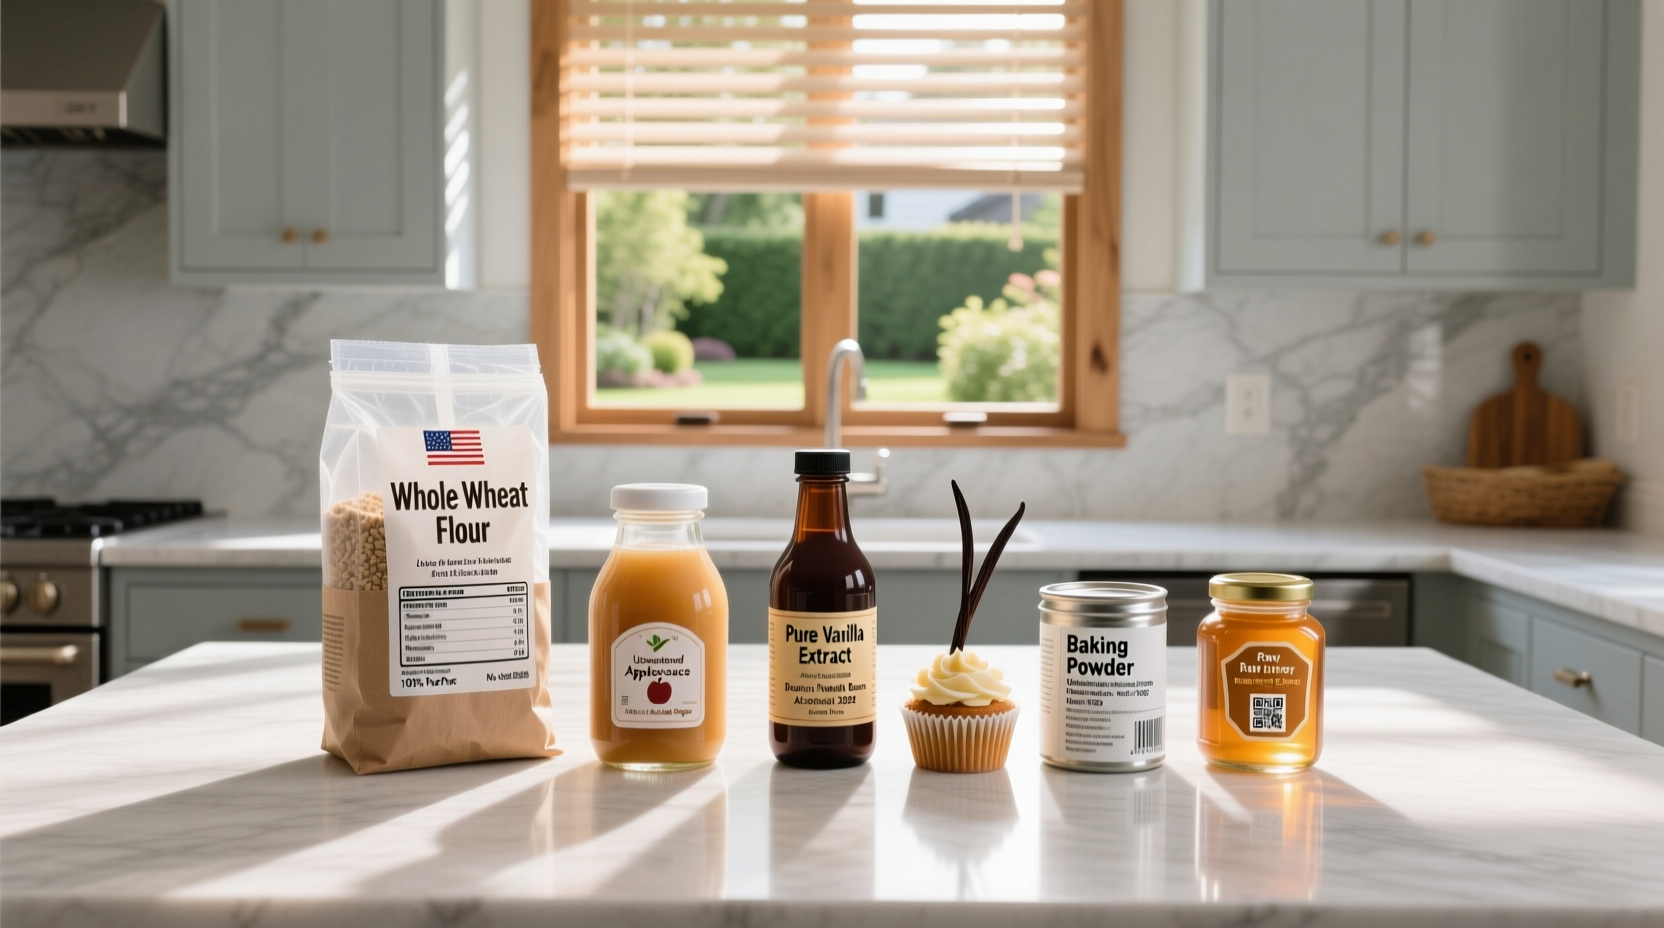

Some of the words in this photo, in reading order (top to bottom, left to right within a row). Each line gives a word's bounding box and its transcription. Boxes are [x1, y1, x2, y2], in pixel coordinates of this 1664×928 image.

[390, 480, 459, 511] Whole
[461, 480, 529, 509] Wheat
[436, 515, 490, 544] Flour
[785, 624, 818, 643] Pure
[799, 646, 852, 664] Extract
[1067, 634, 1128, 658] Baking
[1067, 657, 1134, 676] Powder
